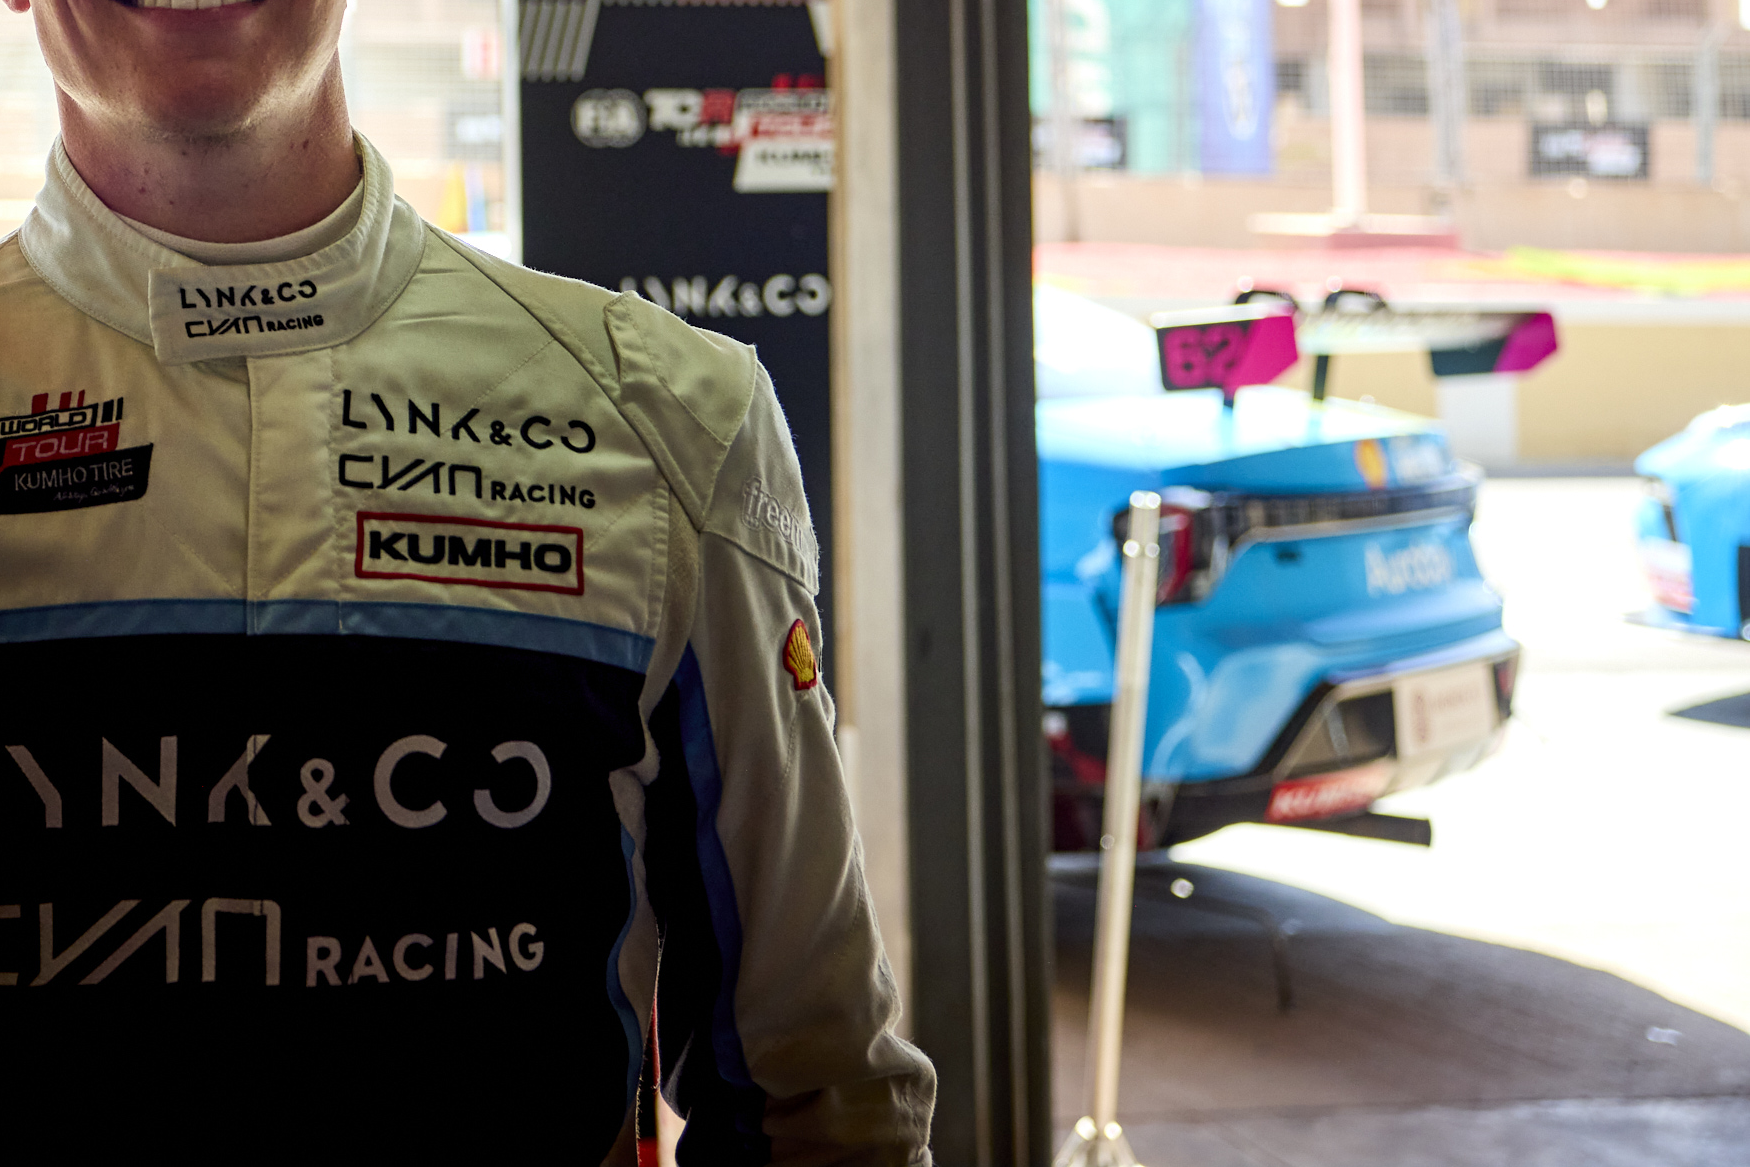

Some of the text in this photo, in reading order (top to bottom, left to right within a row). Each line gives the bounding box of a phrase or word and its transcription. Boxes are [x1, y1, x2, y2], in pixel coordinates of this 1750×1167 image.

[185, 314, 325, 338] CYAN RACING
[0, 410, 88, 437] WORLD
[11, 431, 110, 462] TOUR
[14, 458, 134, 491] KUMHO TIRE
[338, 453, 597, 510] CYAN RACING
[368, 530, 572, 573] KUMHO
[305, 921, 546, 989] RACING
